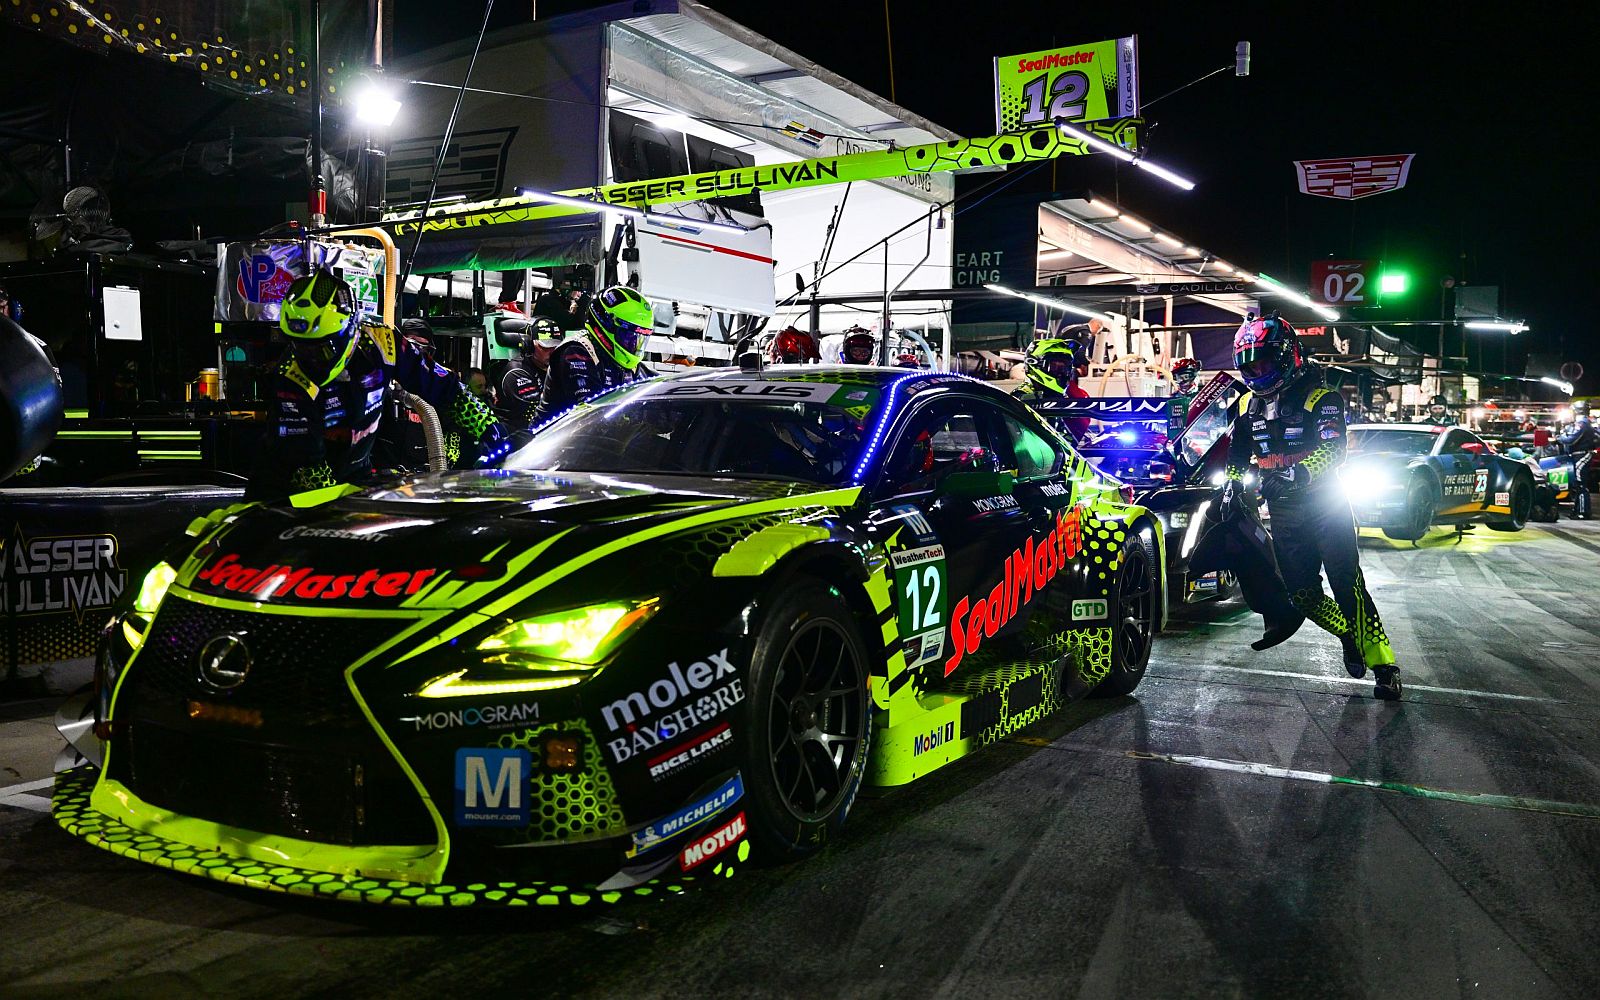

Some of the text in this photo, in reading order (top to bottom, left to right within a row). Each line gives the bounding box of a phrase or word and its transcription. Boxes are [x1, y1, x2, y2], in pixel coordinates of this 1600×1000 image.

[1018, 51, 1095, 74] SealMaster
[1021, 70, 1090, 124] 12
[603, 161, 839, 205] SSER SULLIVAN
[956, 251, 1004, 267] EART
[238, 253, 276, 304] VP
[351, 277, 374, 300] 12
[956, 270, 1001, 285] CING
[1169, 283, 1245, 292] CADILLAC
[1323, 273, 1365, 302] 02
[1295, 326, 1328, 336] ELEN
[655, 385, 815, 398] EXUS
[1039, 480, 1069, 497] molex
[1444, 474, 1476, 484] THE HEART
[1445, 485, 1474, 496] OF RACING
[1475, 474, 1488, 492] 23
[1552, 470, 1566, 485] 27
[972, 494, 1019, 513] MONOGRAM
[893, 548, 944, 565] WeatherTech
[198, 553, 437, 600] SealMaster
[0, 571, 125, 613] ULLIVAN
[905, 565, 941, 632] 12
[944, 505, 1083, 679] SealMaster
[1073, 602, 1106, 617] GTD
[600, 648, 737, 732] molex
[414, 702, 540, 732] MONOGRAM
[649, 728, 733, 777] RICE LAKE
[913, 726, 943, 757] Mobil
[465, 756, 521, 808] M
[662, 786, 736, 834] MICHELIN
[684, 817, 746, 867] MOTUL
